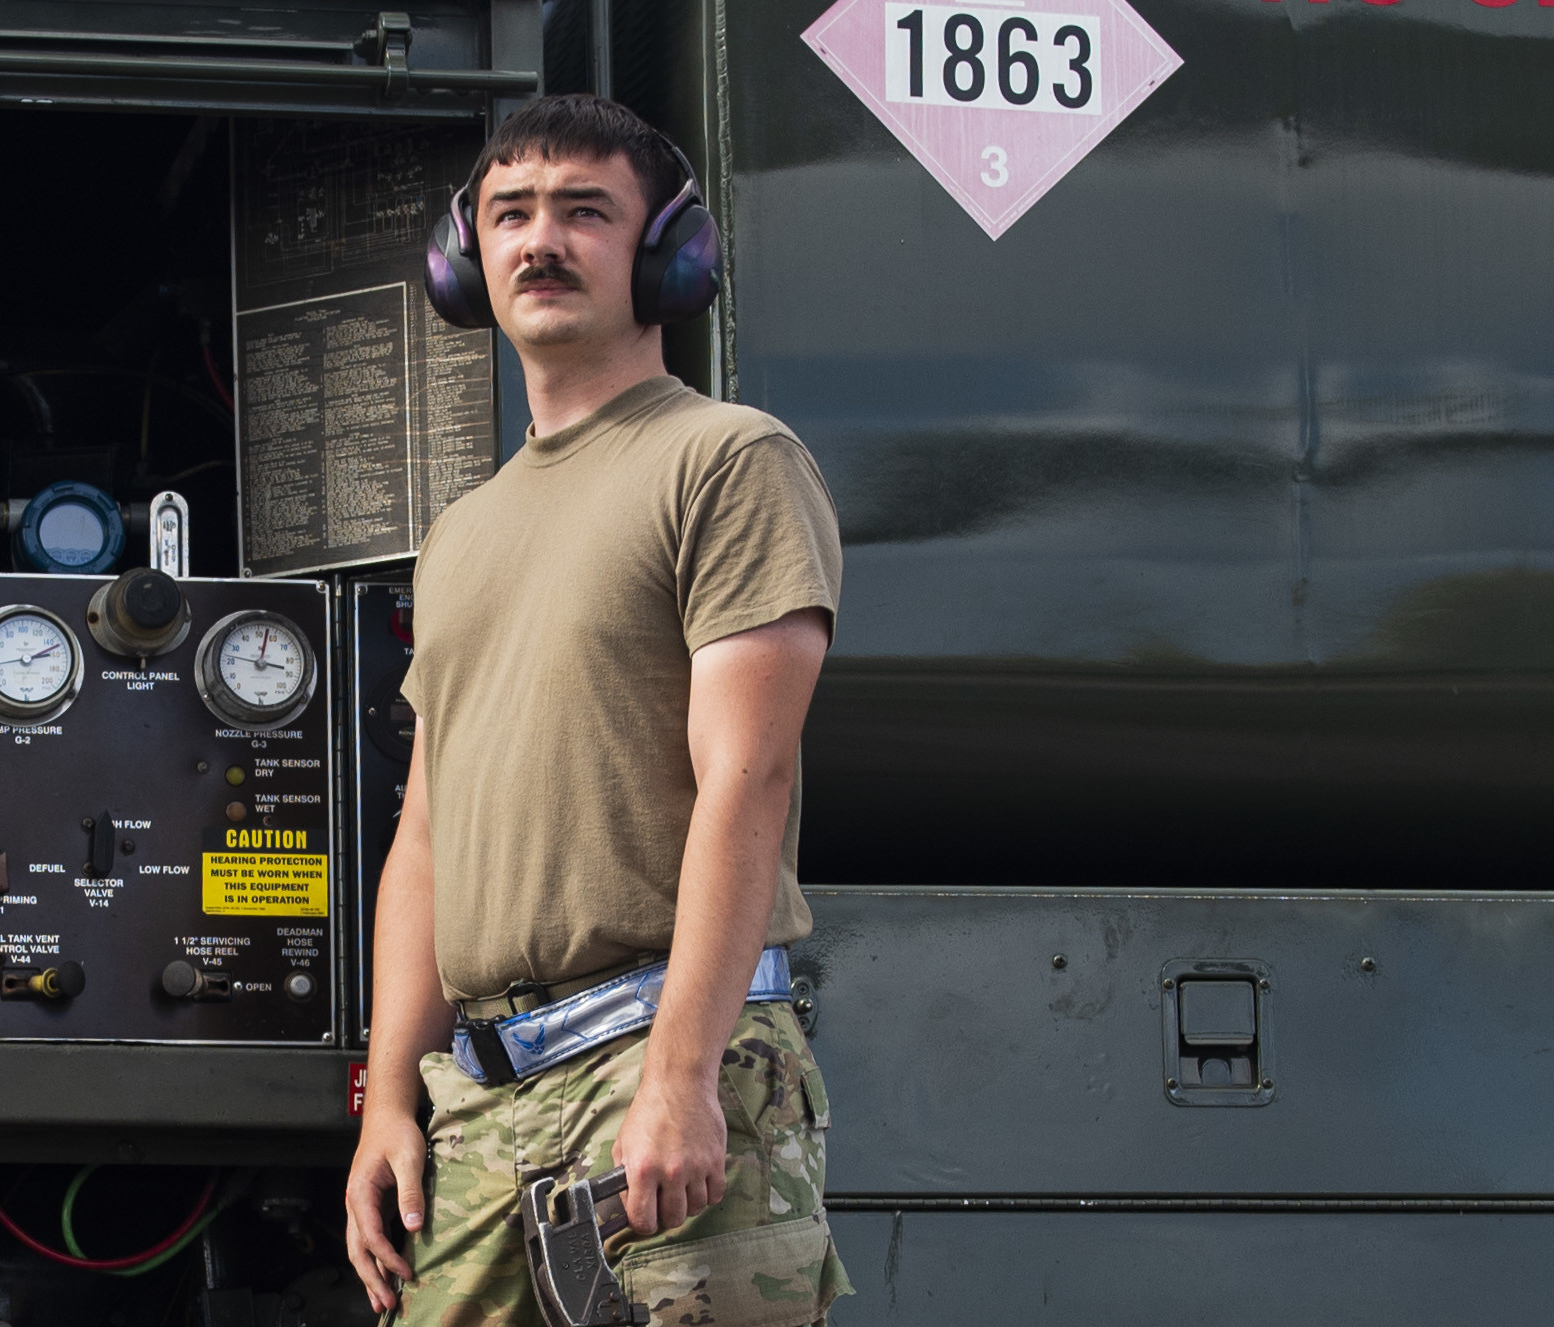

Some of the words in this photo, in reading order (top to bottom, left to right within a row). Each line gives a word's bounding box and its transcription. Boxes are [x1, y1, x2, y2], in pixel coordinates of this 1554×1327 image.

[896, 9, 1093, 109] 1863
[980, 146, 1009, 188] 3
[18, 626, 28, 634] 100
[102, 672, 146, 680] CONTROL
[149, 672, 180, 681] PANEL
[127, 682, 154, 690] LIGHT
[12, 726, 62, 735] PRESSURE
[215, 730, 251, 738] NOZZLE
[253, 730, 303, 740] PRESSURE
[15, 736, 31, 745] G-2
[251, 740, 267, 749] G-3
[255, 759, 280, 768] TANK
[282, 759, 320, 768] SENSOR
[255, 769, 274, 777] DRY
[255, 794, 280, 803] TANK
[282, 795, 321, 804] SENSOR
[255, 804, 276, 813] WET
[124, 820, 152, 829] FLOW
[226, 829, 307, 849] CAUTION
[210, 856, 256, 865] HEARING
[260, 856, 322, 866] PROTECTION
[29, 864, 66, 873] DEFUEL
[139, 866, 160, 874] LOW
[162, 866, 190, 875] FLOW
[210, 869, 238, 878] MUST
[240, 869, 254, 878] BE
[257, 870, 288, 878] WORN
[292, 870, 322, 879] WHEN
[74, 878, 124, 888] SELECTOR
[224, 882, 247, 891] THIS
[250, 882, 310, 892] EQUIPMENT
[84, 889, 114, 898] VALVE
[89, 899, 109, 908] V-14
[224, 895, 235, 904] IS
[238, 895, 248, 904] IN
[251, 896, 310, 904] OPERATION
[277, 928, 323, 936] DEADMAN
[8, 934, 34, 943] TANK
[35, 934, 60, 944] VENT
[174, 937, 179, 946] 1
[181, 936, 198, 946] 1/2"
[200, 937, 251, 946] SERVICING
[287, 938, 313, 946] HOSE
[29, 944, 60, 954] VALVE
[186, 948, 212, 956] HOSE
[214, 948, 239, 956] REEL
[282, 948, 319, 957] REWIND
[11, 955, 31, 964] V-44
[202, 958, 222, 966] V-45
[290, 958, 310, 967] V-46
[246, 983, 272, 992] OPEN
